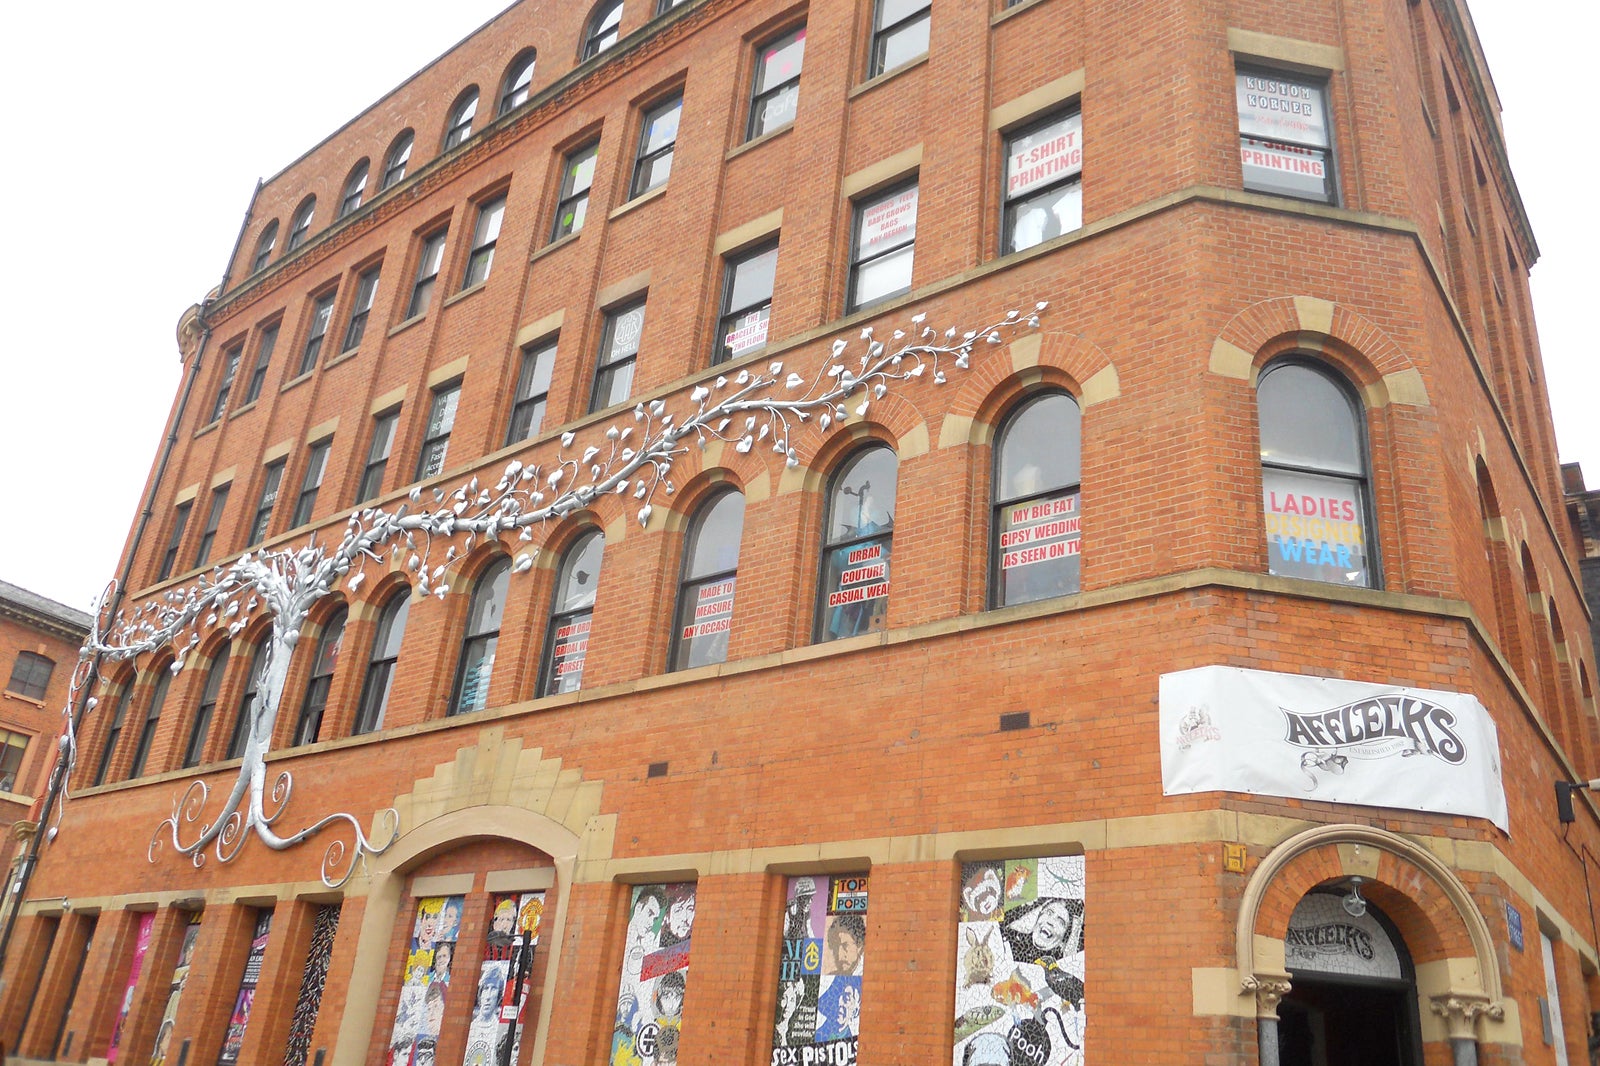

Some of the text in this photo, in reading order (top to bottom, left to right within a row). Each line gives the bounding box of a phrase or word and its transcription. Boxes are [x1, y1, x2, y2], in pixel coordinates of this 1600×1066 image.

[1246, 77, 1311, 99] KUSTOM
[1247, 94, 1312, 116] KORNER
[1016, 132, 1075, 169] T-SHIRT
[1009, 149, 1080, 192] PRINTING
[1242, 150, 1322, 176] PRINTING
[867, 203, 911, 227] BABY GROWS
[880, 218, 899, 231] BAGS
[727, 325, 756, 343] BRACELET
[1013, 498, 1073, 523] MY BIG FAT
[1270, 491, 1355, 521] LADIES
[1001, 528, 1031, 547] GIPSY
[1266, 513, 1364, 545] DESIGNER
[849, 546, 880, 563] URBAN
[1003, 540, 1080, 567] AS SEEN ON TV
[1276, 537, 1352, 569] WEAR
[842, 566, 884, 584] COUTURE
[700, 582, 733, 599] MADE TO
[829, 583, 890, 606] CASUAL WEA
[696, 600, 732, 617] MEASURE
[557, 625, 577, 638] PROM
[683, 625, 699, 639] ANY
[1286, 695, 1465, 765] AFFLECKS
[840, 879, 867, 892] TOP
[838, 898, 866, 910] POPS
[1286, 923, 1374, 961] AFFLECKS
[805, 1013, 815, 1021] God
